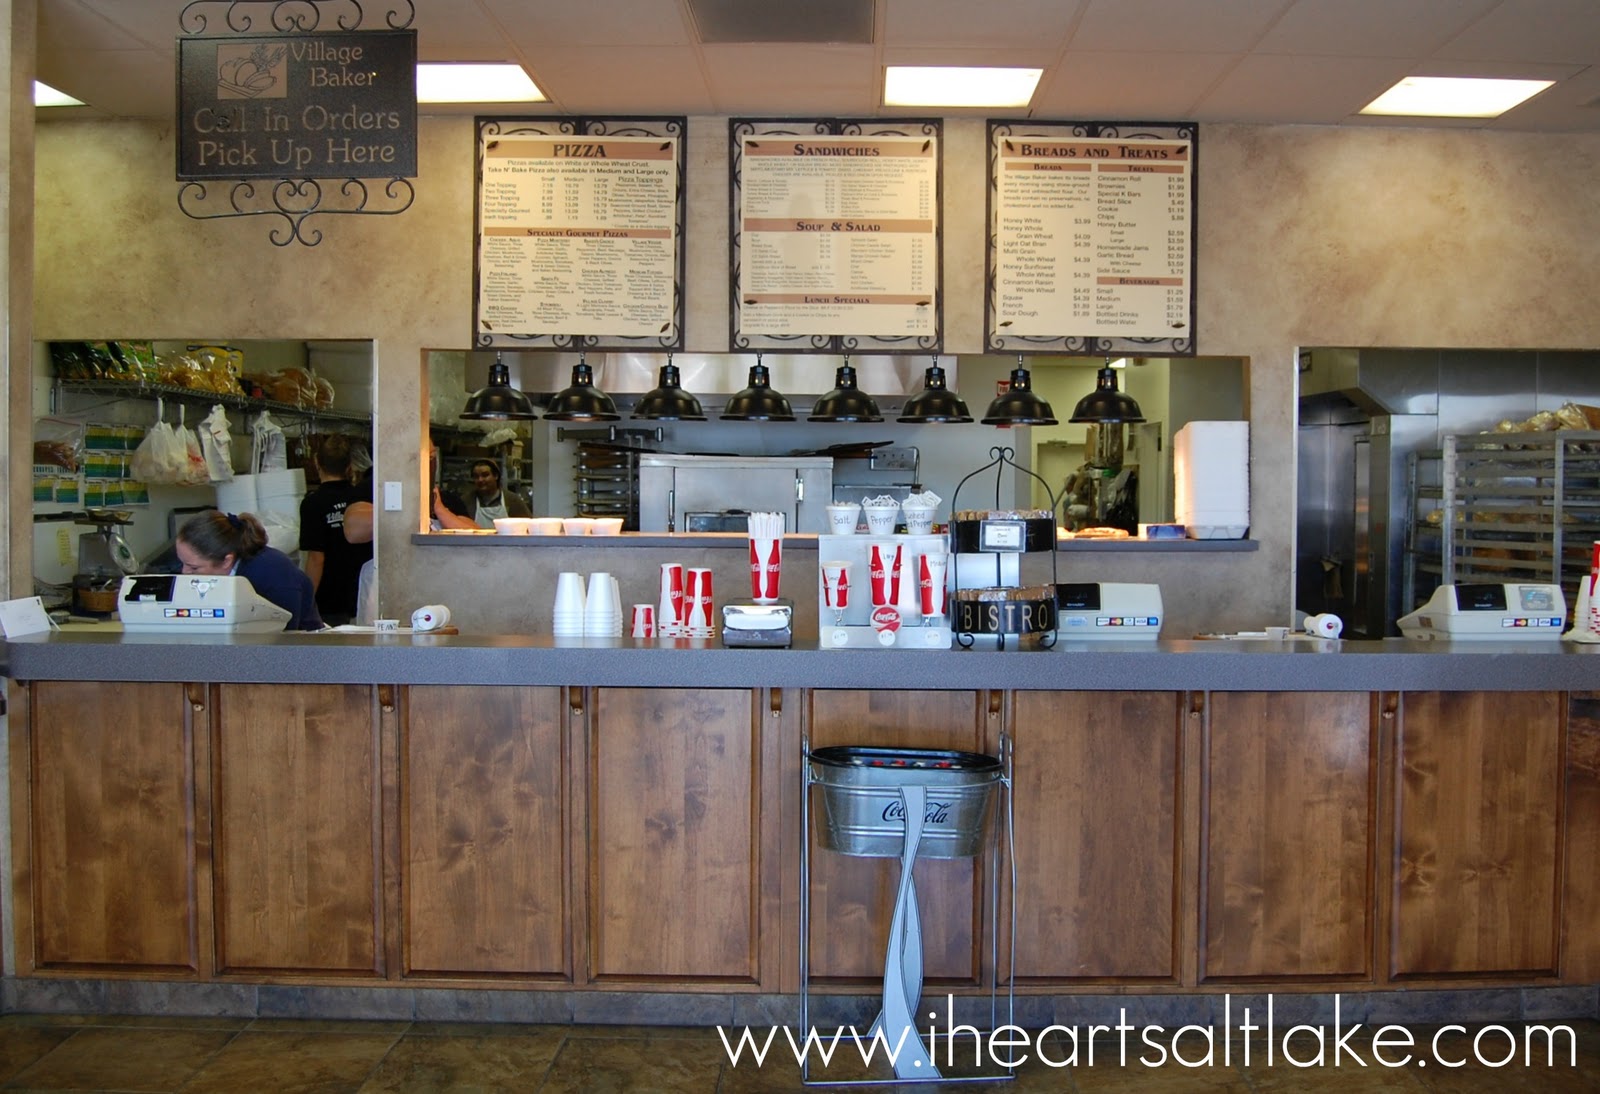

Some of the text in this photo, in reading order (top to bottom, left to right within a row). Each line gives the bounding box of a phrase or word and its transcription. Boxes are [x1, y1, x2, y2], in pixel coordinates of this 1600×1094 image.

[290, 43, 363, 65] Village
[311, 67, 376, 87] Baker
[194, 105, 400, 133] Call In Orders
[198, 138, 395, 169] Pick Up Here
[553, 144, 607, 158] PIZZA
[794, 144, 879, 156] SANDWICHES
[1021, 144, 1168, 159] BREADS AND TREATS
[566, 229, 600, 237] GOURMET
[796, 221, 880, 231] SOUP & SALAD
[805, 296, 869, 304] LUNCH SPECIALS
[834, 515, 850, 525] Salt
[870, 515, 893, 526] Pepper
[913, 520, 932, 528] Pepper
[964, 604, 1047, 631] BISTRO
[882, 801, 952, 823] Cocola
